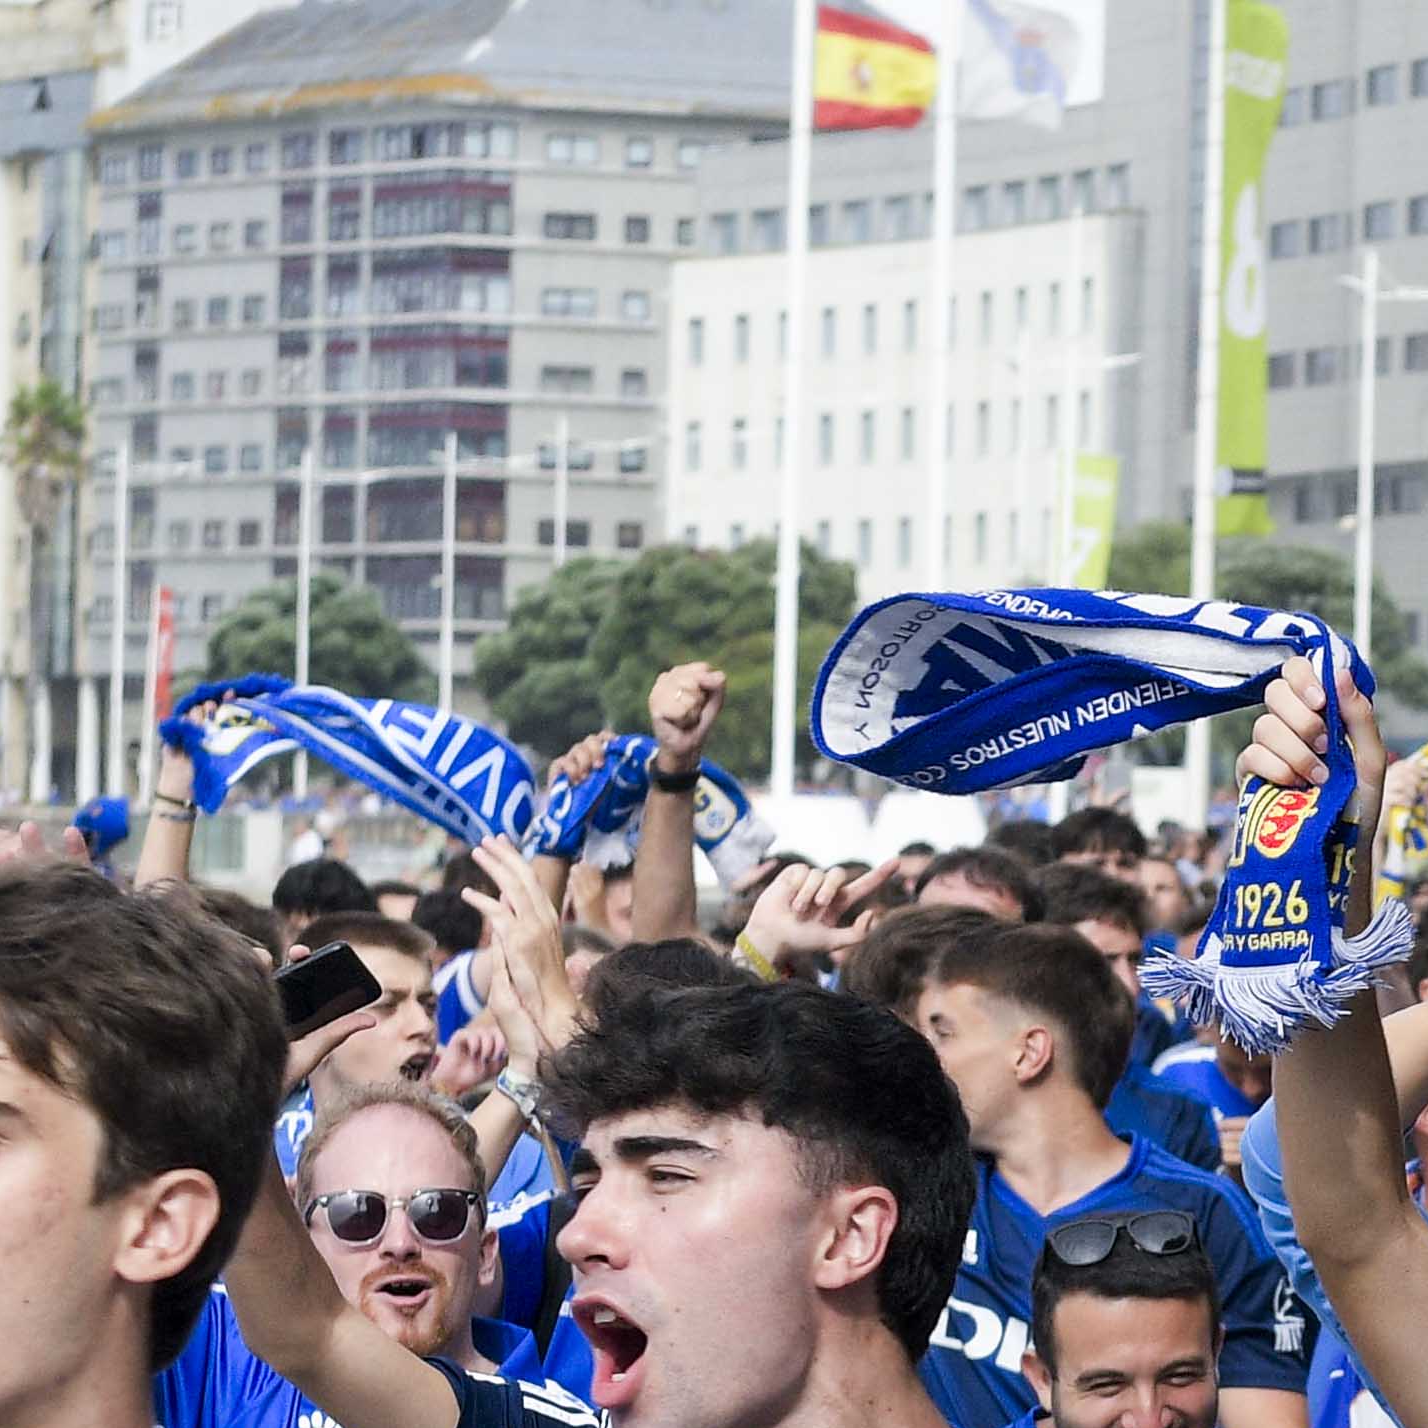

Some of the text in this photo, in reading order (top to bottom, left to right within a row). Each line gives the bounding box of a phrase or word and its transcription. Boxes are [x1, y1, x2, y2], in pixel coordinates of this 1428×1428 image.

[950, 709, 1071, 771] NUESTROS
[1235, 879, 1309, 929] 1926
[1247, 929, 1310, 952] GARRA
